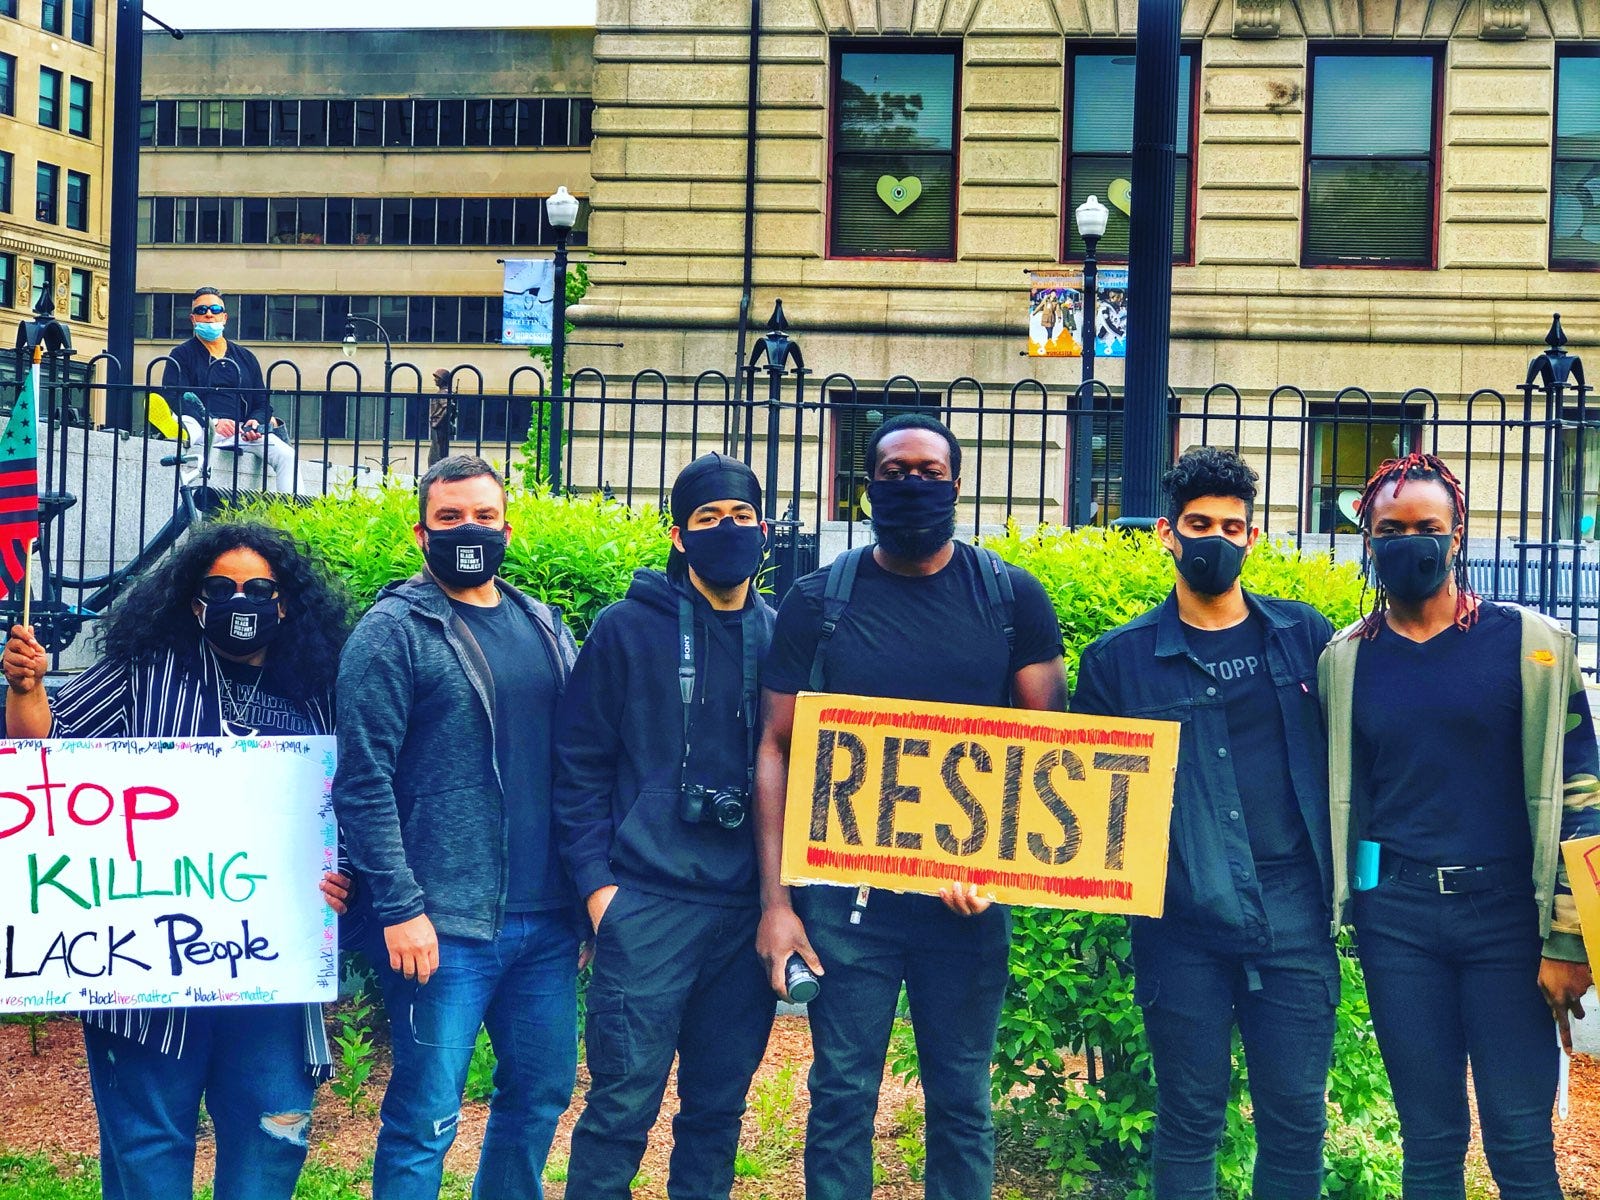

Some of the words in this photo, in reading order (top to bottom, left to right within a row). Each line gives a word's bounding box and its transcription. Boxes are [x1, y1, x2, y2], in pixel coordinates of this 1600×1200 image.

[1205, 655, 1259, 680] TOPP
[808, 728, 1151, 871] RESIST
[28, 851, 268, 914] KILLING
[0, 924, 151, 979] LACK
[154, 912, 279, 979] People
[79, 987, 180, 1006] #blacklivesmatter
[185, 985, 279, 1003] #blacklivesmatter
